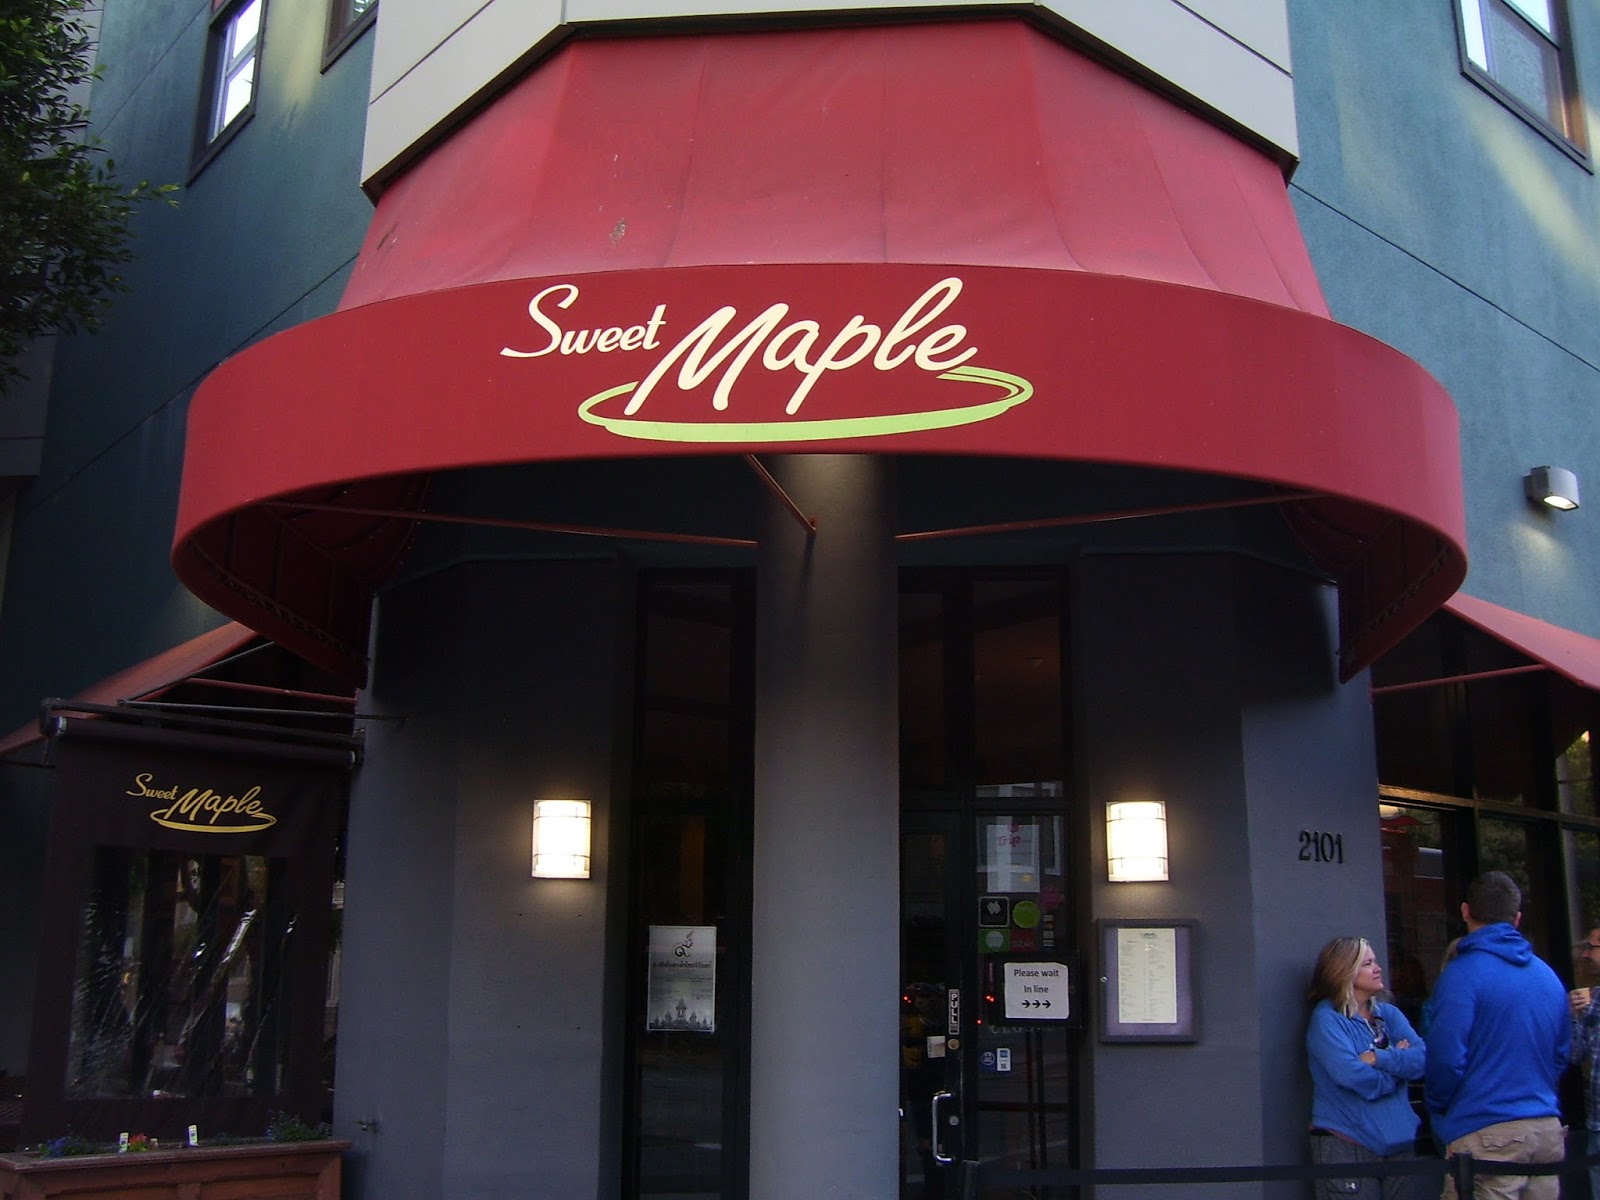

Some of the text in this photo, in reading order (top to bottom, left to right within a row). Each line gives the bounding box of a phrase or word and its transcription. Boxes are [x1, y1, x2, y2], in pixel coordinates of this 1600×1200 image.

[500, 276, 979, 415] Sweet Maple
[126, 773, 264, 824] Sweet Maple
[1298, 830, 1344, 864] 2101
[1013, 968, 1060, 977] Please wait
[1033, 984, 1049, 994] line
[950, 993, 959, 1024] PULL
